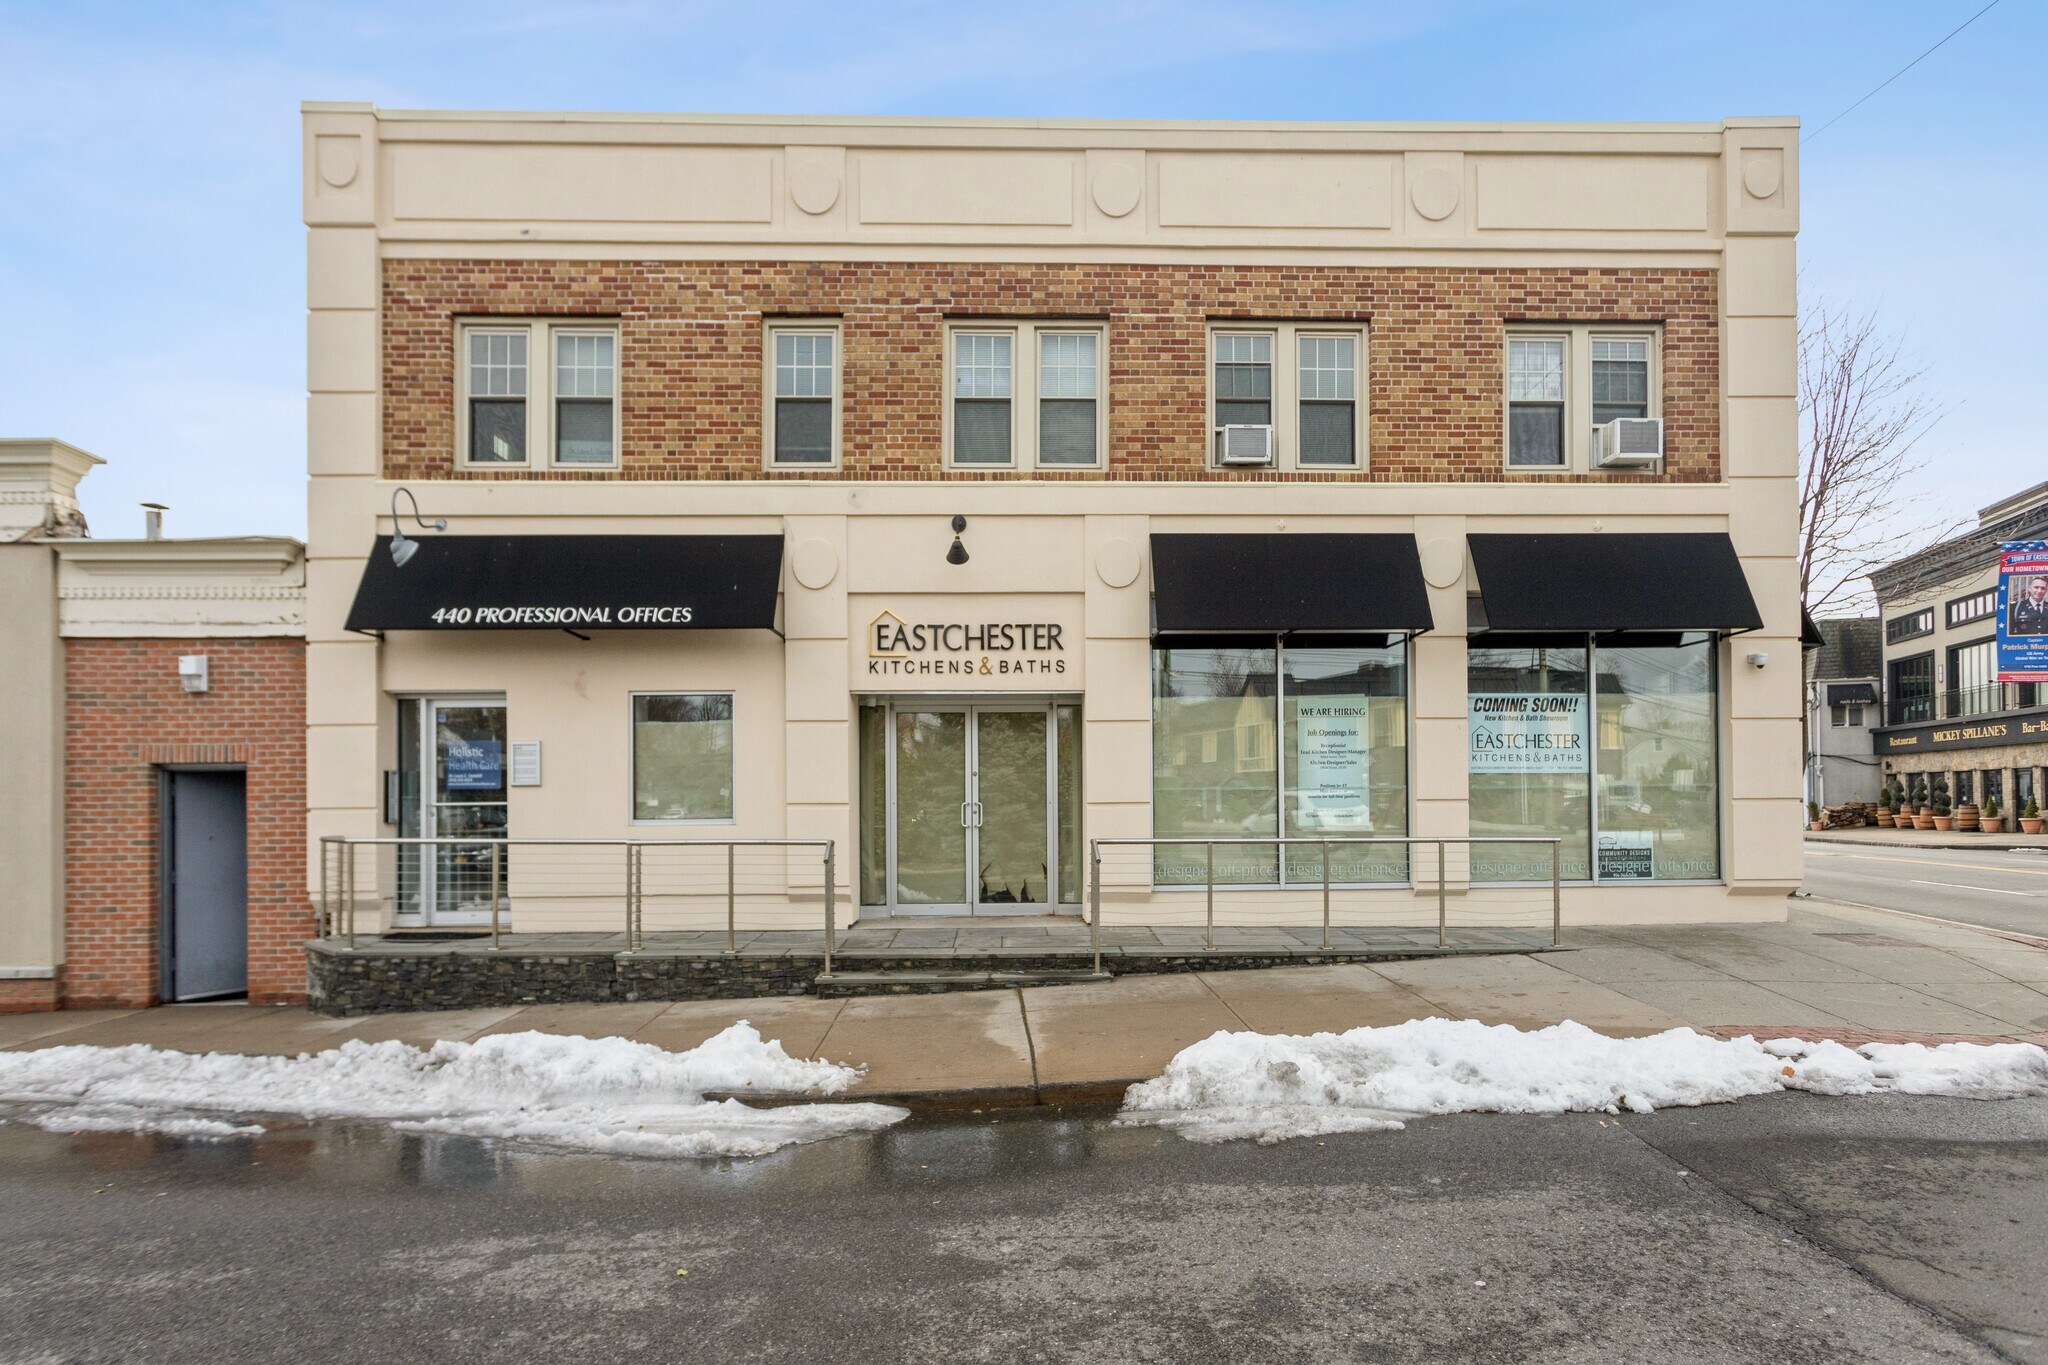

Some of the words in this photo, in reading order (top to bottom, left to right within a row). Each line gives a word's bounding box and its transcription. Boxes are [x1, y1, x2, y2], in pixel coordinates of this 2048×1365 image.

[431, 608, 472, 624] 440
[475, 607, 613, 624] PROFESSIONAL
[617, 607, 692, 623] OFFICES
[876, 624, 1065, 651] EASTCHESTER
[869, 661, 974, 675] KITCHENS
[979, 657, 994, 676] &
[1000, 660, 1066, 674] BATHS
[1301, 708, 1314, 716] WE
[1316, 708, 1331, 716] ARE
[1334, 708, 1366, 716] HIRING
[1473, 698, 1528, 713] COMING
[1531, 698, 1579, 713] SOON!!
[1319, 729, 1347, 737] Openings
[1933, 730, 1961, 742] MICKEY
[1963, 725, 2007, 739] SPILLANE'S
[1476, 734, 1581, 749] EASTCHESTER
[449, 746, 484, 757] Holistic
[1472, 754, 1530, 762] KITCHENS
[1533, 752, 1541, 763] &
[1545, 754, 1582, 762] BATHS
[449, 761, 478, 770] Health
[480, 761, 499, 770] Care
[1288, 861, 1343, 881] desiger
[1471, 859, 1527, 879] designer
[1660, 857, 1715, 876] off-price
